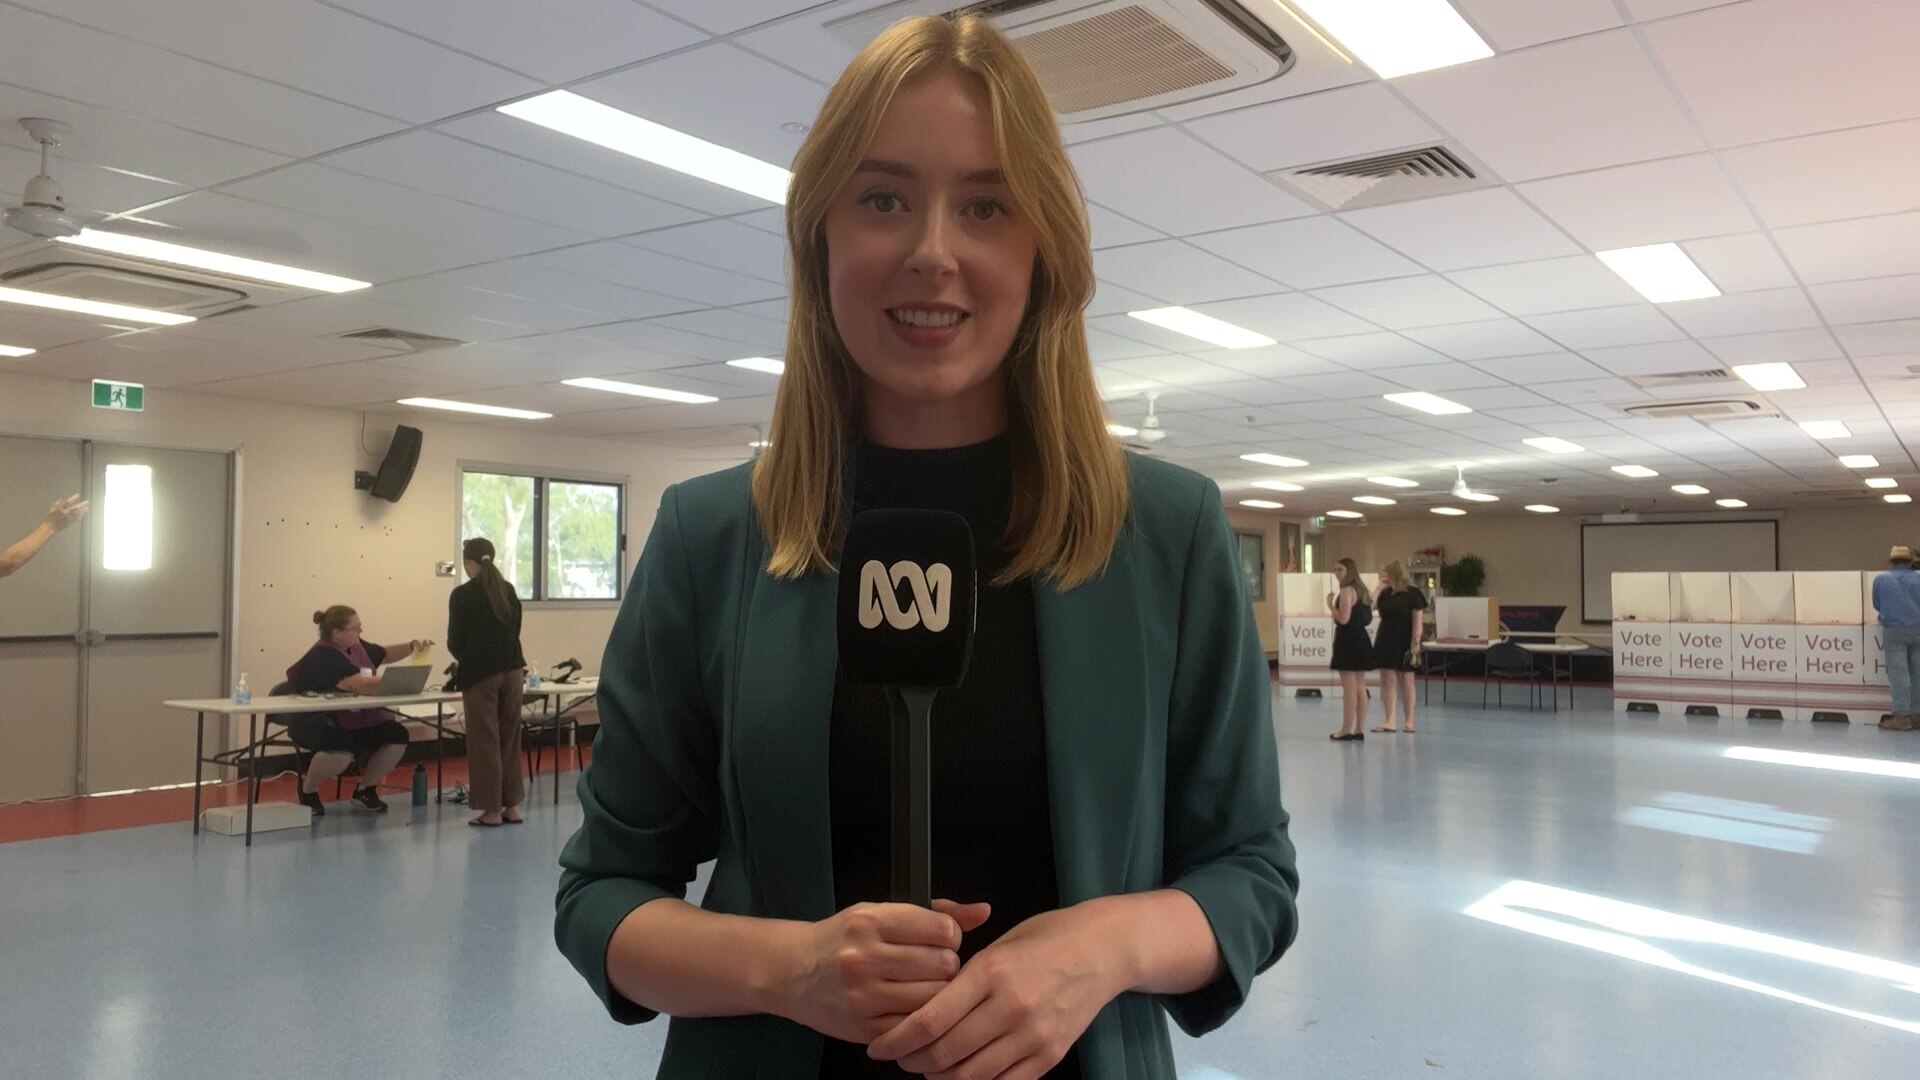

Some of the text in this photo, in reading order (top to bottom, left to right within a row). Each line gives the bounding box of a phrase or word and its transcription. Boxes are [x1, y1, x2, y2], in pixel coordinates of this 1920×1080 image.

[1291, 624, 1326, 639] Vote
[1620, 630, 1662, 647] Vote
[1679, 631, 1723, 648] Vote
[1291, 643, 1327, 657] Here
[1740, 633, 1787, 650] Vote
[1805, 634, 1853, 652] Vote
[1621, 651, 1663, 668] Here
[1680, 653, 1724, 670] Here
[1741, 655, 1788, 672] Here
[1806, 657, 1854, 674] Here
